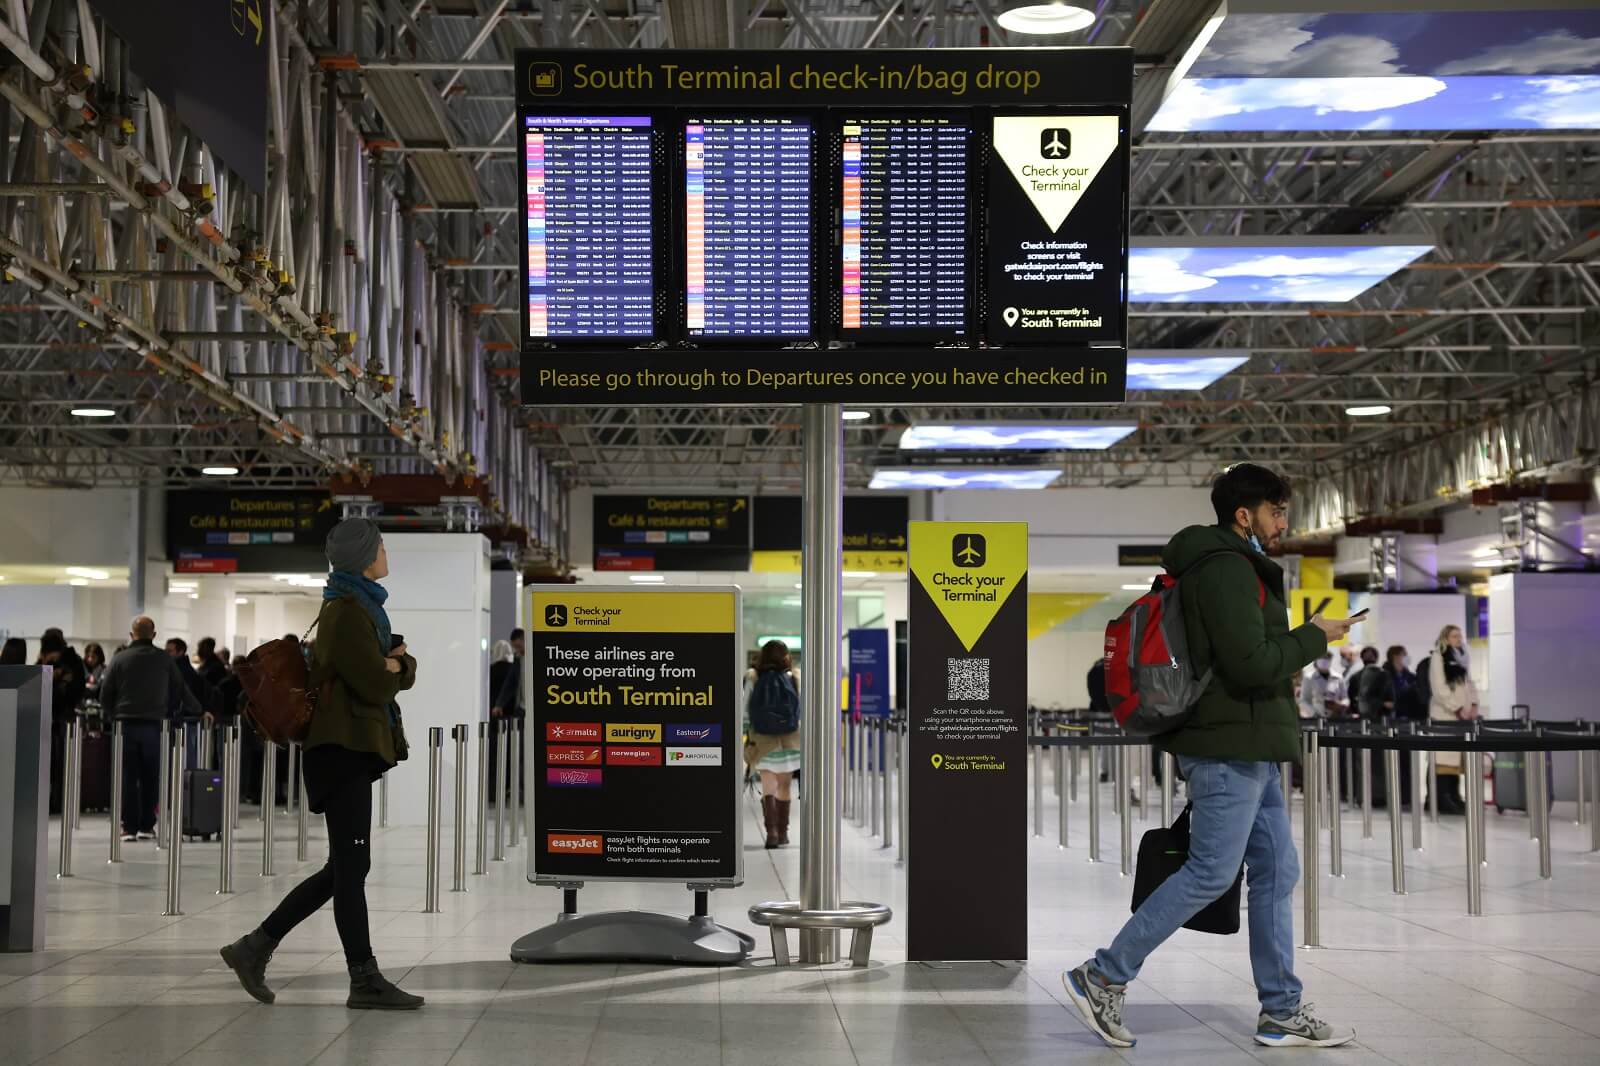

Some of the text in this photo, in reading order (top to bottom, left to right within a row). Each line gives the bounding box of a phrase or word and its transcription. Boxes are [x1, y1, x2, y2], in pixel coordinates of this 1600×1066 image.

[574, 64, 1040, 95] South Terminal check-in/bag drop
[1022, 165, 1088, 179] Check your
[1030, 180, 1081, 192] Terminal
[1004, 262, 1103, 272] gatwickairport.com/flights
[1050, 308, 1081, 316] currently
[1022, 317, 1102, 328] South Terminal
[540, 367, 1106, 390] Please go through to Departures once you have checked in
[231, 499, 295, 512] Departures
[648, 498, 710, 511] Departures
[190, 516, 216, 528] Café
[231, 517, 295, 528] restaurants
[608, 514, 634, 526] Café
[648, 516, 710, 526] restaurants
[933, 572, 1005, 588] Check your
[942, 587, 996, 602] Terminal
[574, 606, 622, 618] Check your
[574, 616, 611, 625] Terminal
[546, 646, 674, 660] These airlines are
[547, 664, 695, 681] now operating from
[548, 685, 712, 705] South Terminal
[612, 727, 656, 740] aurigny
[940, 724, 1018, 732] gatwickairport.com/flights
[669, 752, 684, 760] TAP
[970, 761, 1004, 770] Terminal
[552, 839, 598, 849] easyJet
[607, 836, 634, 845] easyJet
[637, 836, 660, 845] flights
[627, 845, 645, 853] both
[647, 845, 681, 854] terminals
